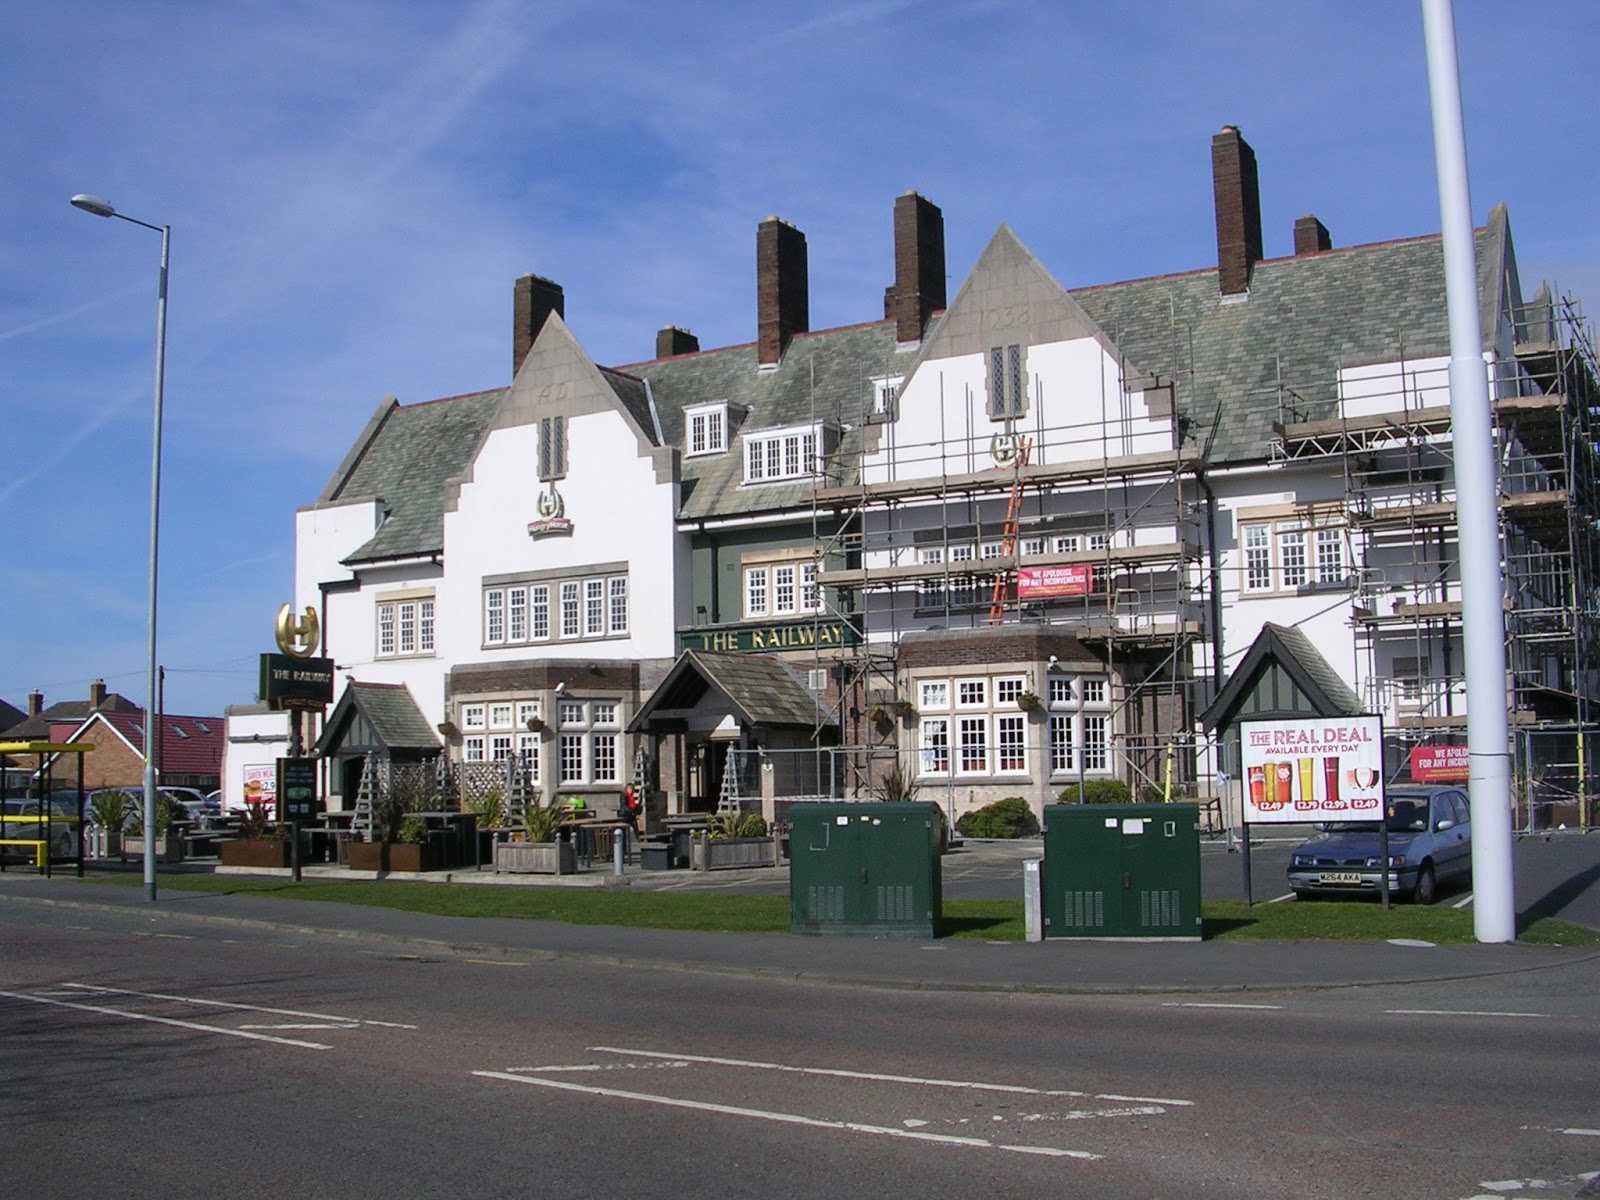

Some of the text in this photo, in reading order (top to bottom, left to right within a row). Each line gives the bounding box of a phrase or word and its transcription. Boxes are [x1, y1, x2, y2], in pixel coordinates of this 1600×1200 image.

[1032, 570, 1042, 578] WE
[1019, 578, 1030, 587] FOR
[1031, 578, 1042, 587] ANY
[703, 624, 844, 651] THE RAILWAY
[272, 669, 332, 683] THE RAILWAY
[1250, 726, 1373, 745] THE REAL DEAL
[1265, 743, 1360, 755] AVAILABLE EVERY DAY
[1434, 749, 1446, 758] WE
[1418, 759, 1432, 769] FOR
[1433, 758, 1446, 768] ANY
[1260, 801, 1282, 810] £2.49
[1296, 801, 1318, 810] £2.79
[1323, 800, 1345, 809] £2.99
[1353, 799, 1376, 808] £2.49
[1343, 873, 1360, 881] AKA
